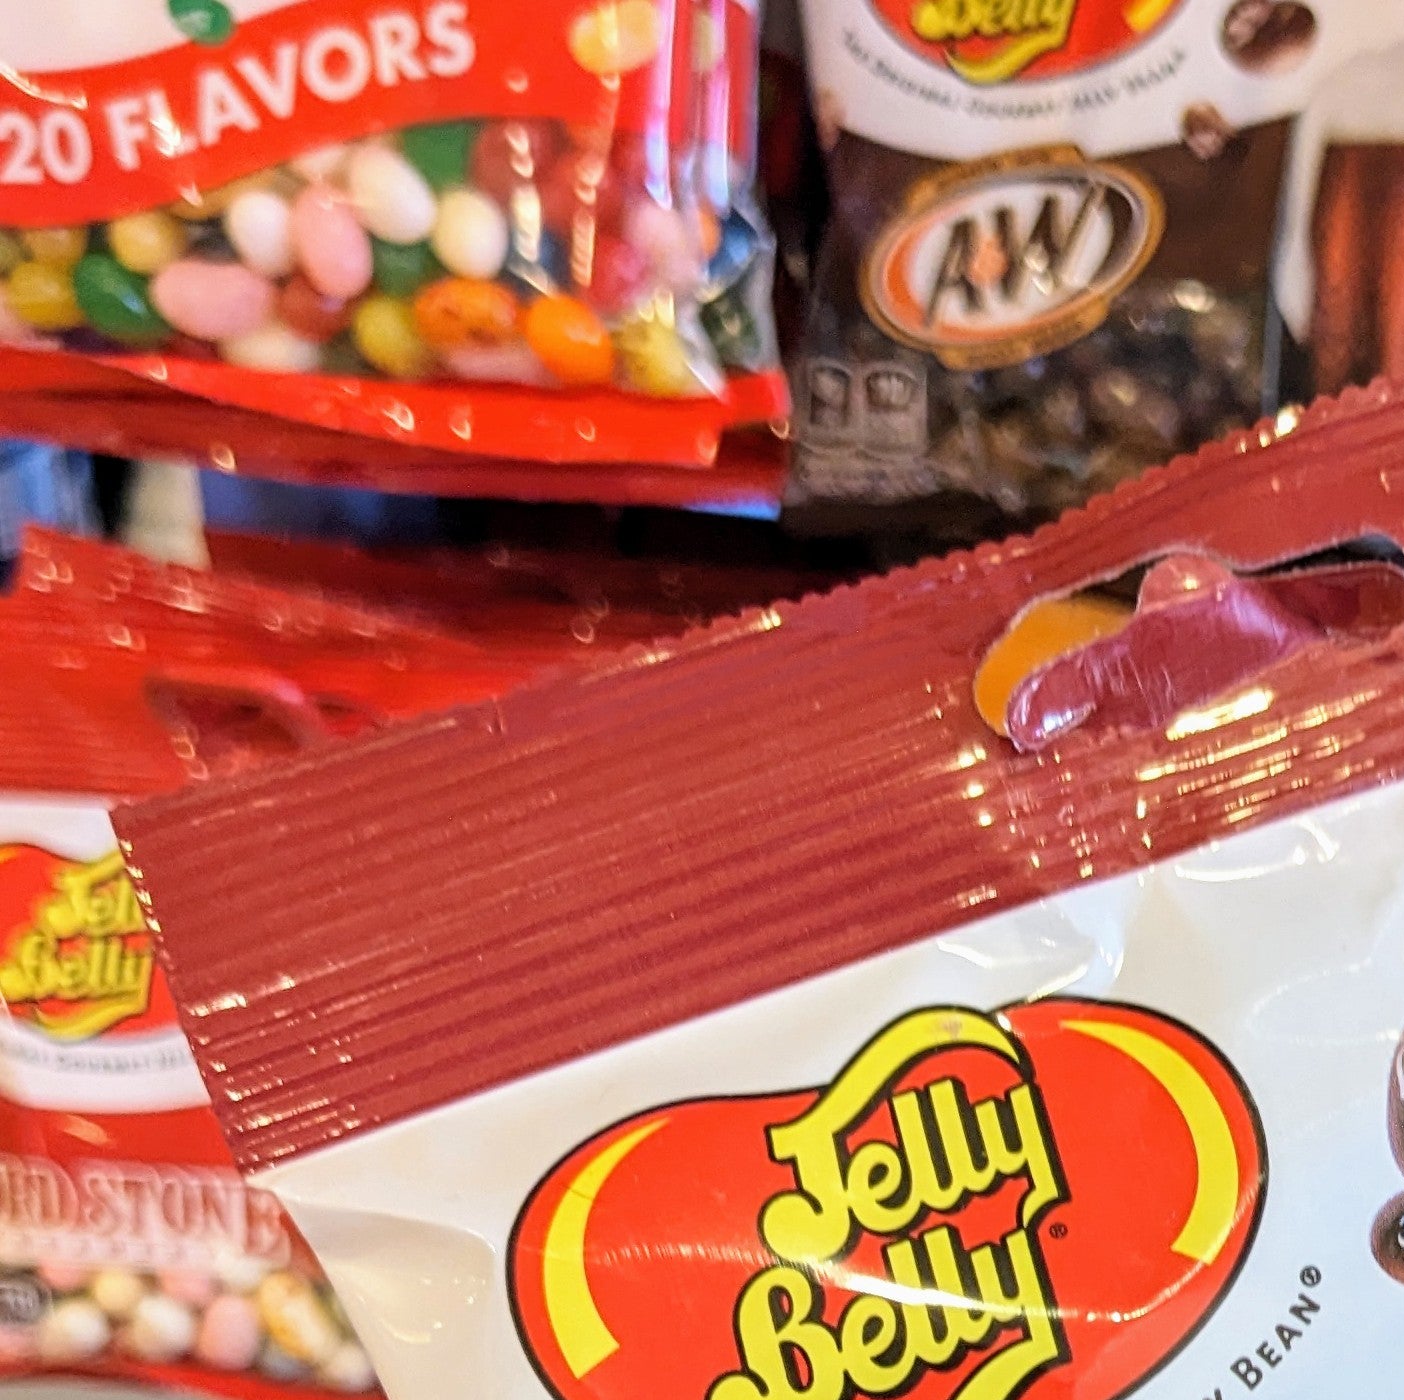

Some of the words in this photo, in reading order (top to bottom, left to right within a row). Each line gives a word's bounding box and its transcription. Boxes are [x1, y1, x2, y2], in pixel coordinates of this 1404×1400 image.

[0, 108, 92, 187] 20
[105, 0, 478, 172] FLAVORS
[757, 1003, 1072, 1265] Jelly
